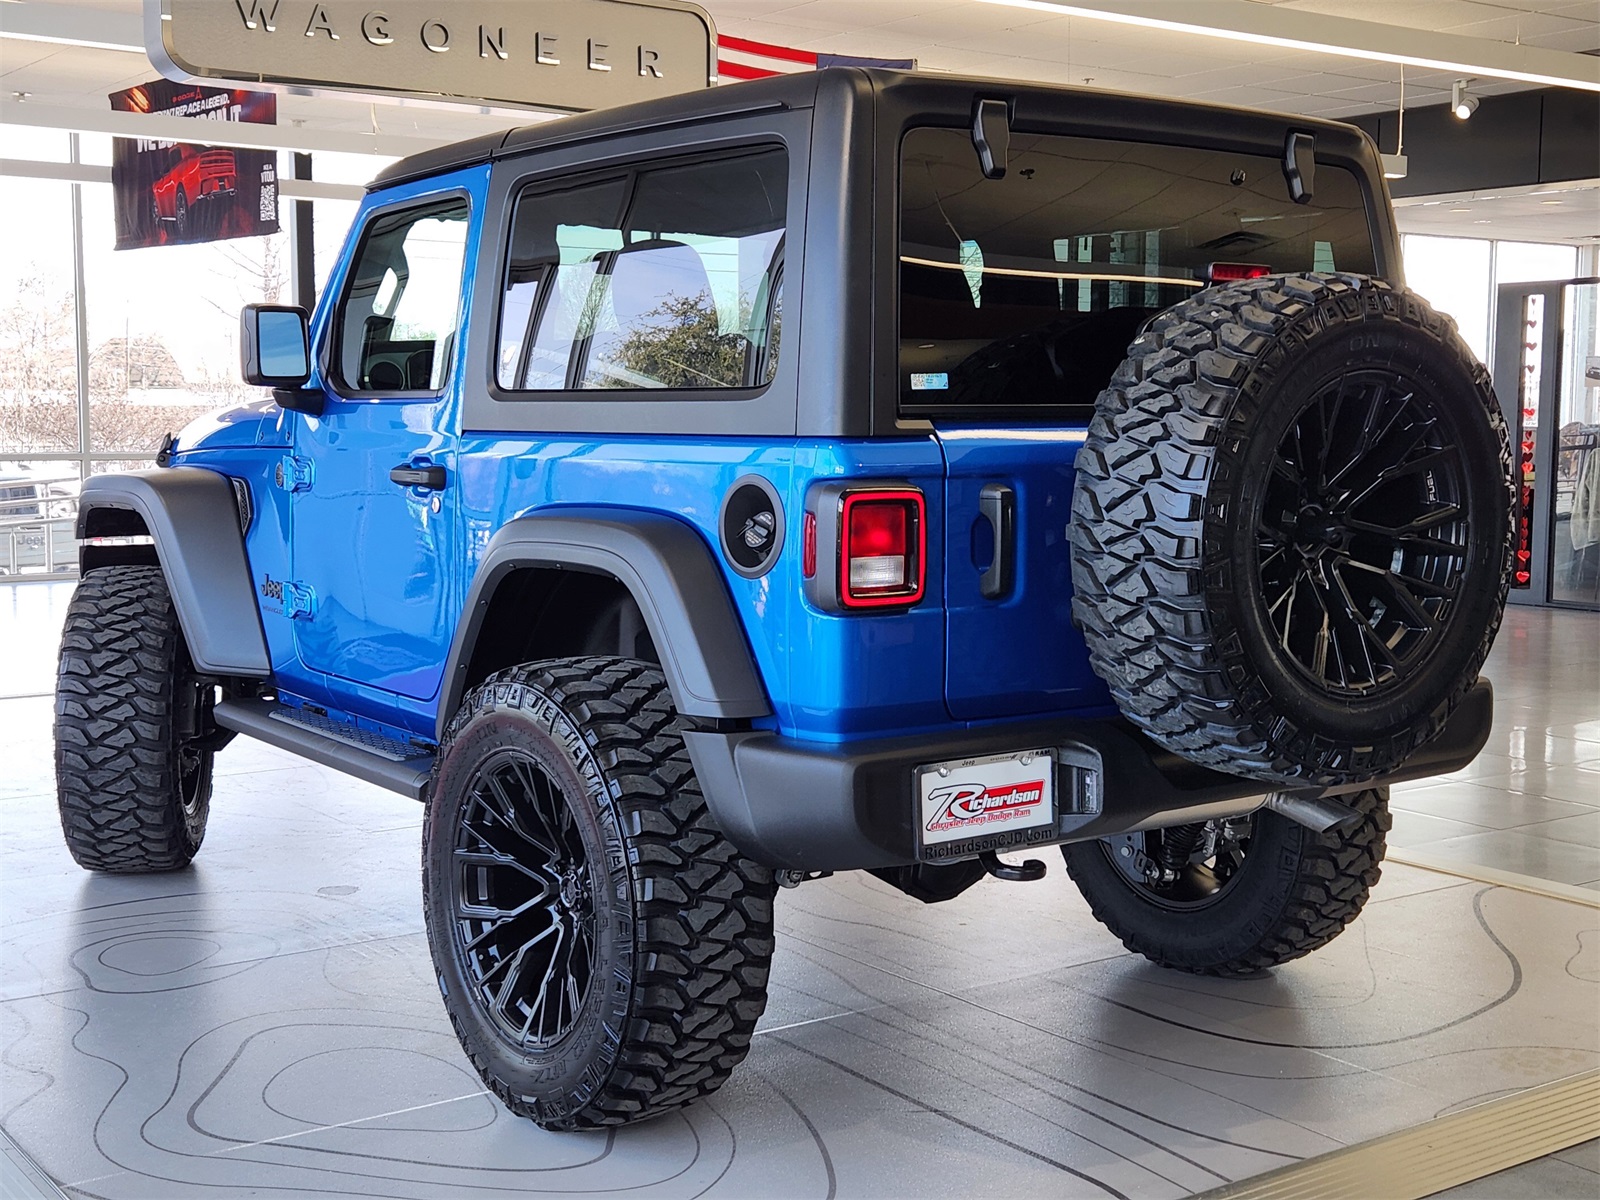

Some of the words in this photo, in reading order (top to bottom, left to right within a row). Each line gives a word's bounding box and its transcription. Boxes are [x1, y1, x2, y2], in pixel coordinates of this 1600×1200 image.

[235, 0, 664, 78] WAGONEER
[926, 783, 1041, 832] Richardson
[930, 819, 965, 832] Chrysler
[966, 816, 987, 826] Jeep
[987, 811, 1013, 822] Dodge
[1013, 808, 1031, 818] Ram
[925, 829, 1053, 860] RichardsonCJD.com
